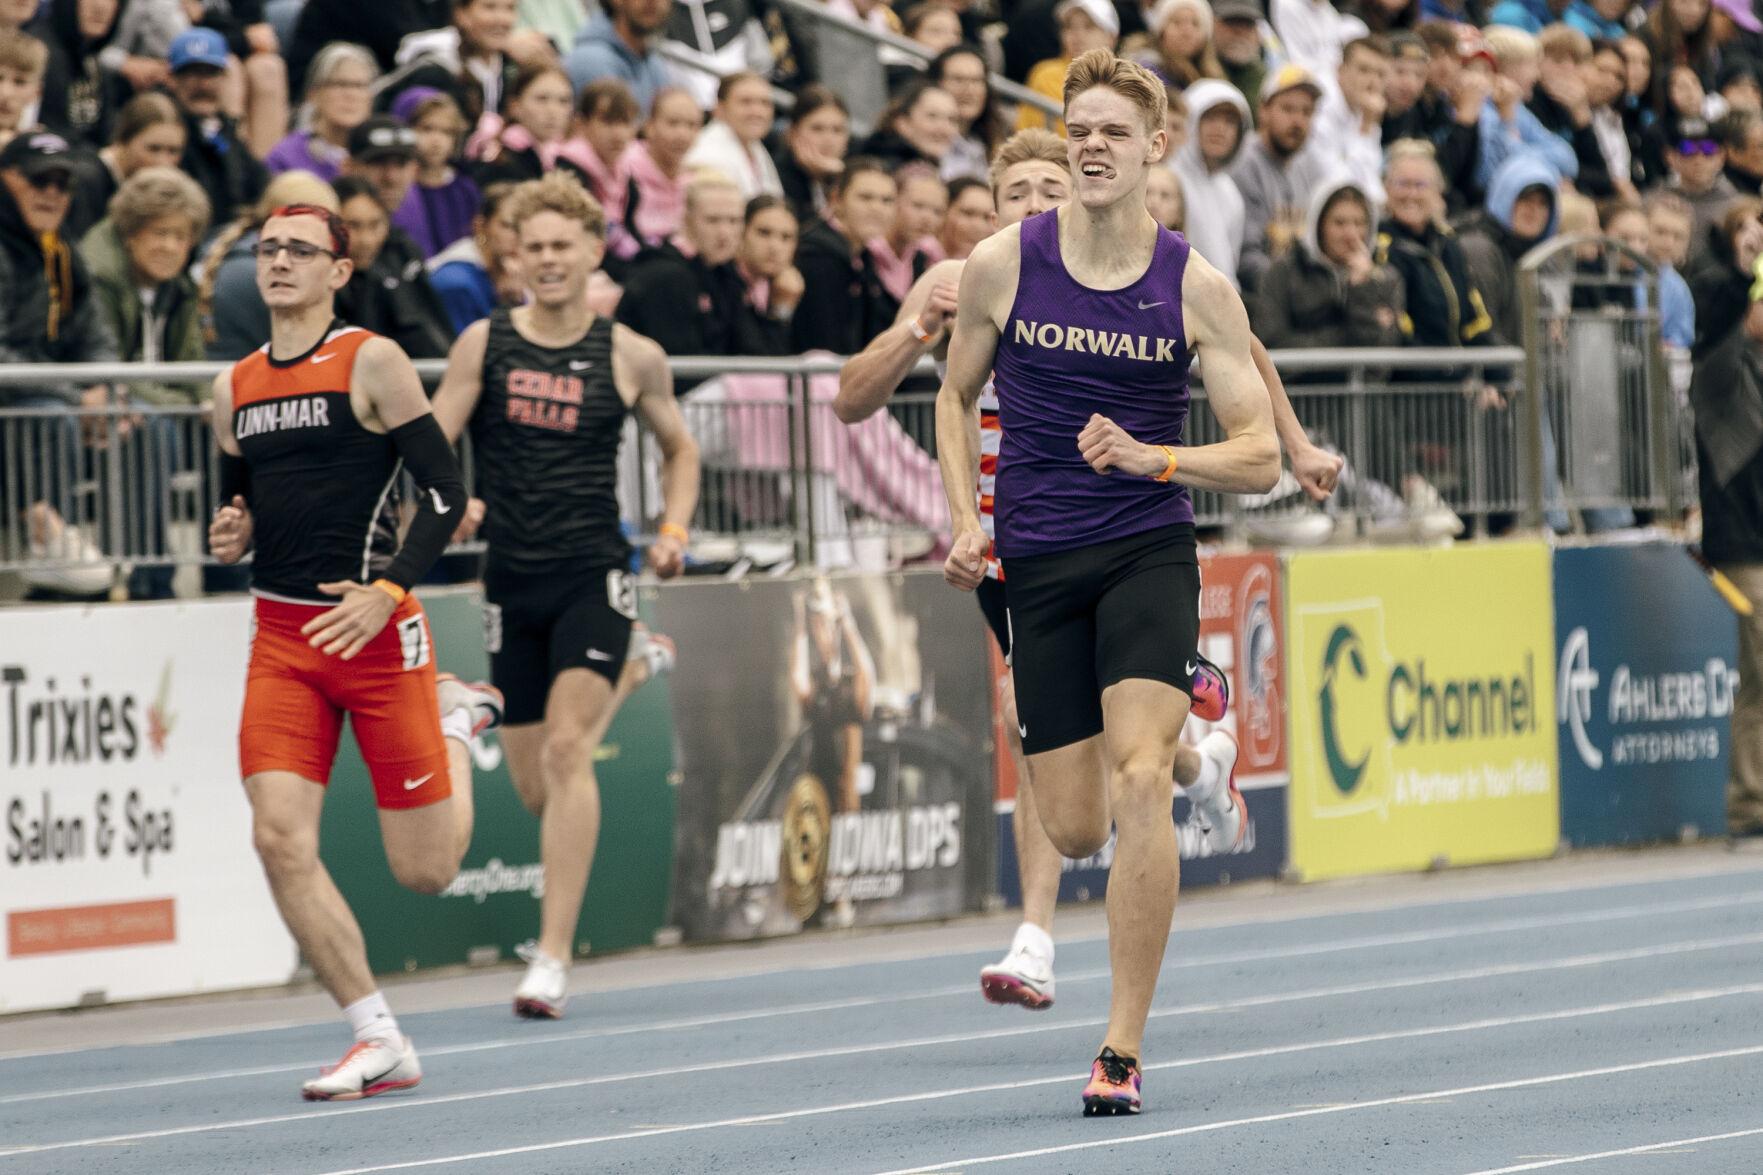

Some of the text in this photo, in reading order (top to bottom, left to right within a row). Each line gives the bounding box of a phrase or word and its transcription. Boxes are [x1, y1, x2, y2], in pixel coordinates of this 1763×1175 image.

[1014, 319, 1177, 362] NORWALK
[506, 368, 583, 405] CEDAR
[236, 396, 329, 439] LINN-MAR
[507, 397, 579, 432] FALLS
[406, 619, 422, 666] 7
[2, 667, 138, 766] Trixies
[1387, 651, 1535, 742] Channel
[1609, 664, 1706, 724] AHLERS
[1611, 728, 1719, 765] ATTORNEYS
[7, 788, 173, 877] Salon & Spa
[711, 822, 782, 888] JOIN
[828, 811, 903, 876] IOWA
[905, 803, 961, 869] DPS
